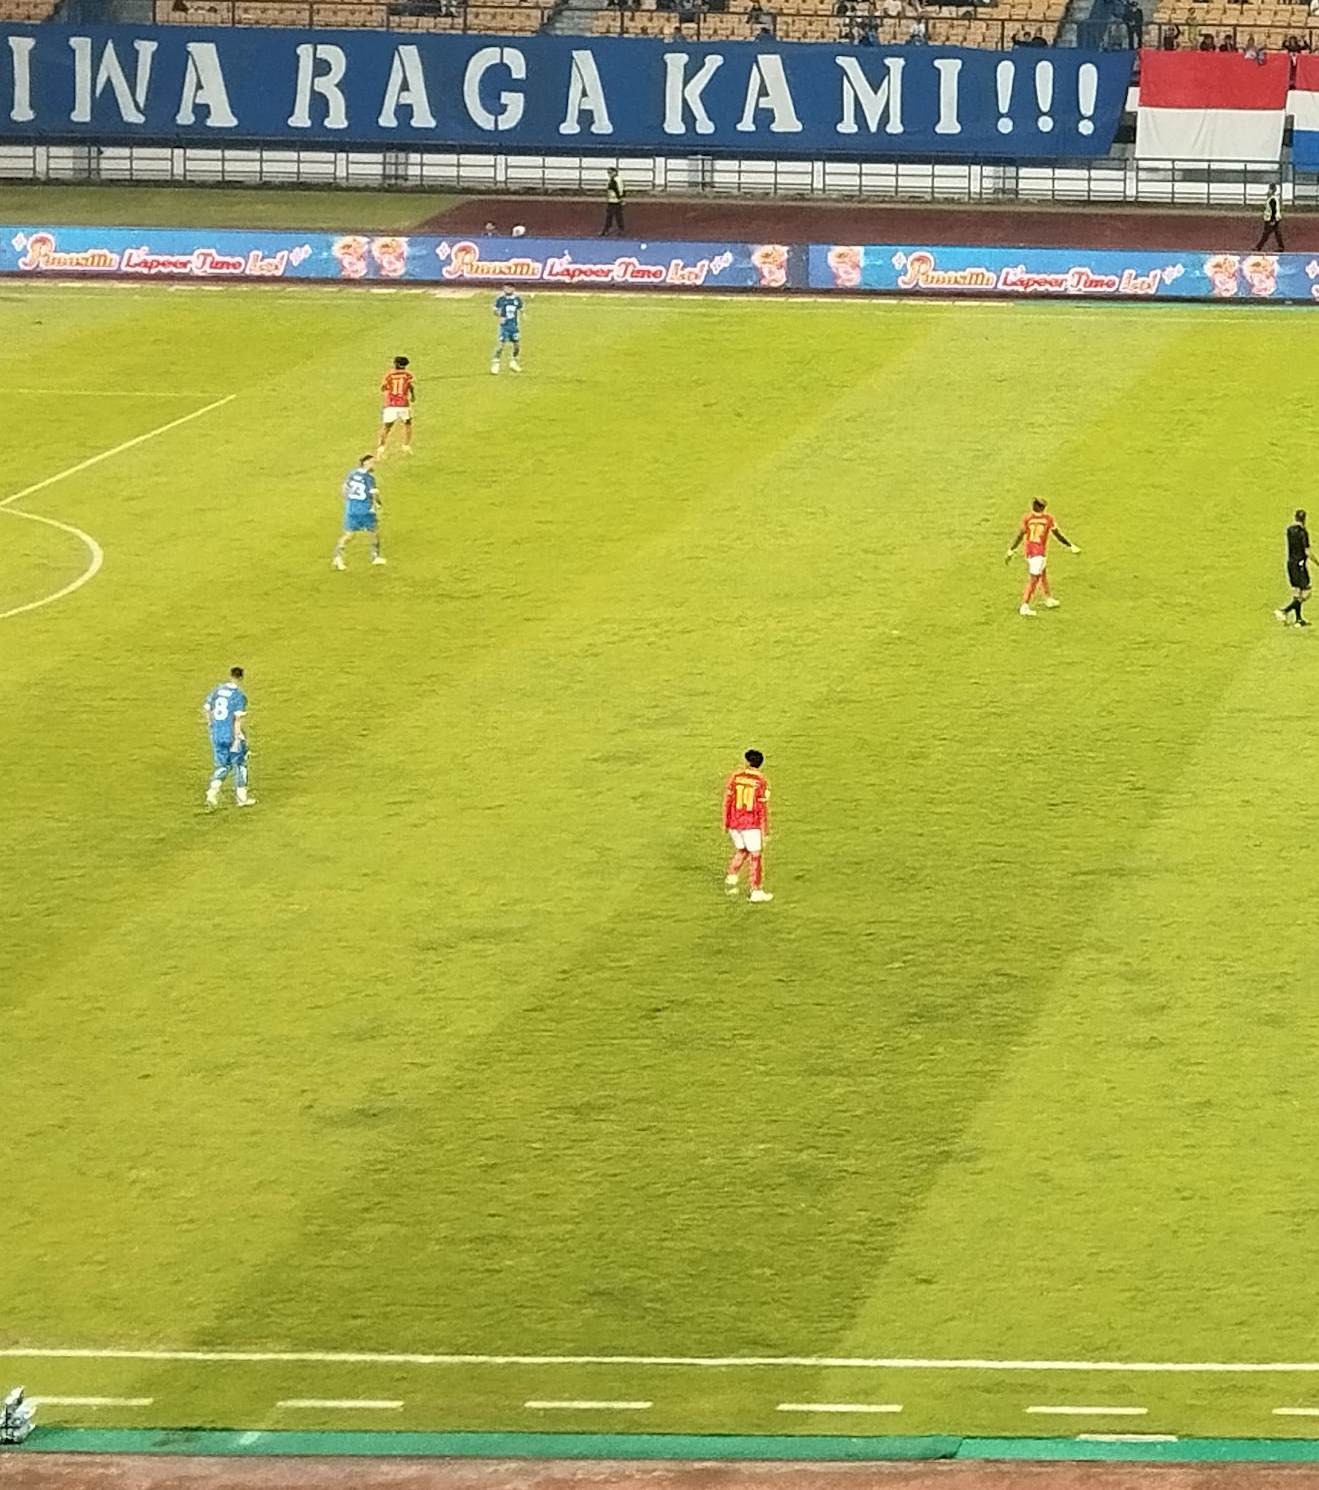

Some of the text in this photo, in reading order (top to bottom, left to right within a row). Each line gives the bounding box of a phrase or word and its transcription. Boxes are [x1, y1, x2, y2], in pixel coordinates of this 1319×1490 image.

[288, 43, 614, 135] RAGA
[663, 52, 1099, 136] KAMI!!!
[213, 696, 229, 721] 8
